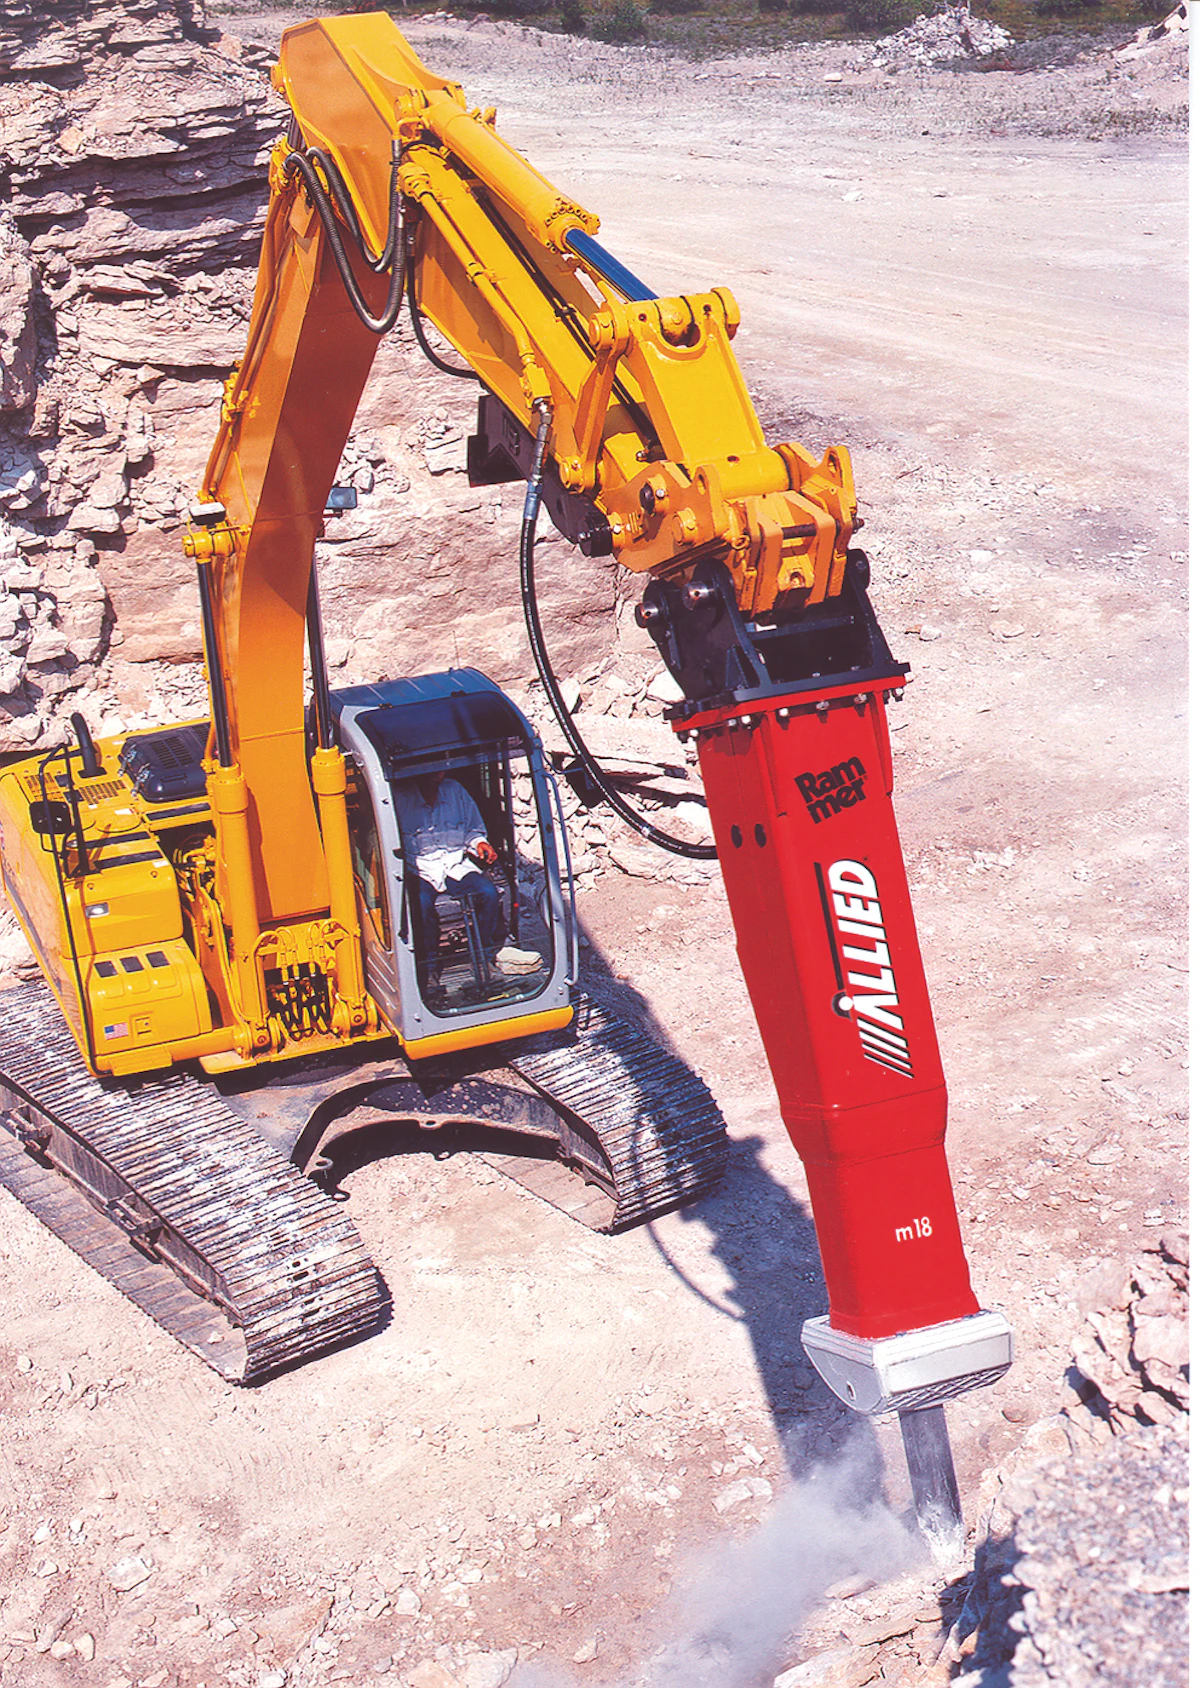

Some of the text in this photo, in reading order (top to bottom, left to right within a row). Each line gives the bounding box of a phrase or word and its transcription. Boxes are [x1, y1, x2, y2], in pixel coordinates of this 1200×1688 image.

[794, 757, 866, 804] Ram
[806, 778, 867, 824] mer
[828, 859, 904, 1031] ALLIED
[895, 1216, 932, 1242] m18
